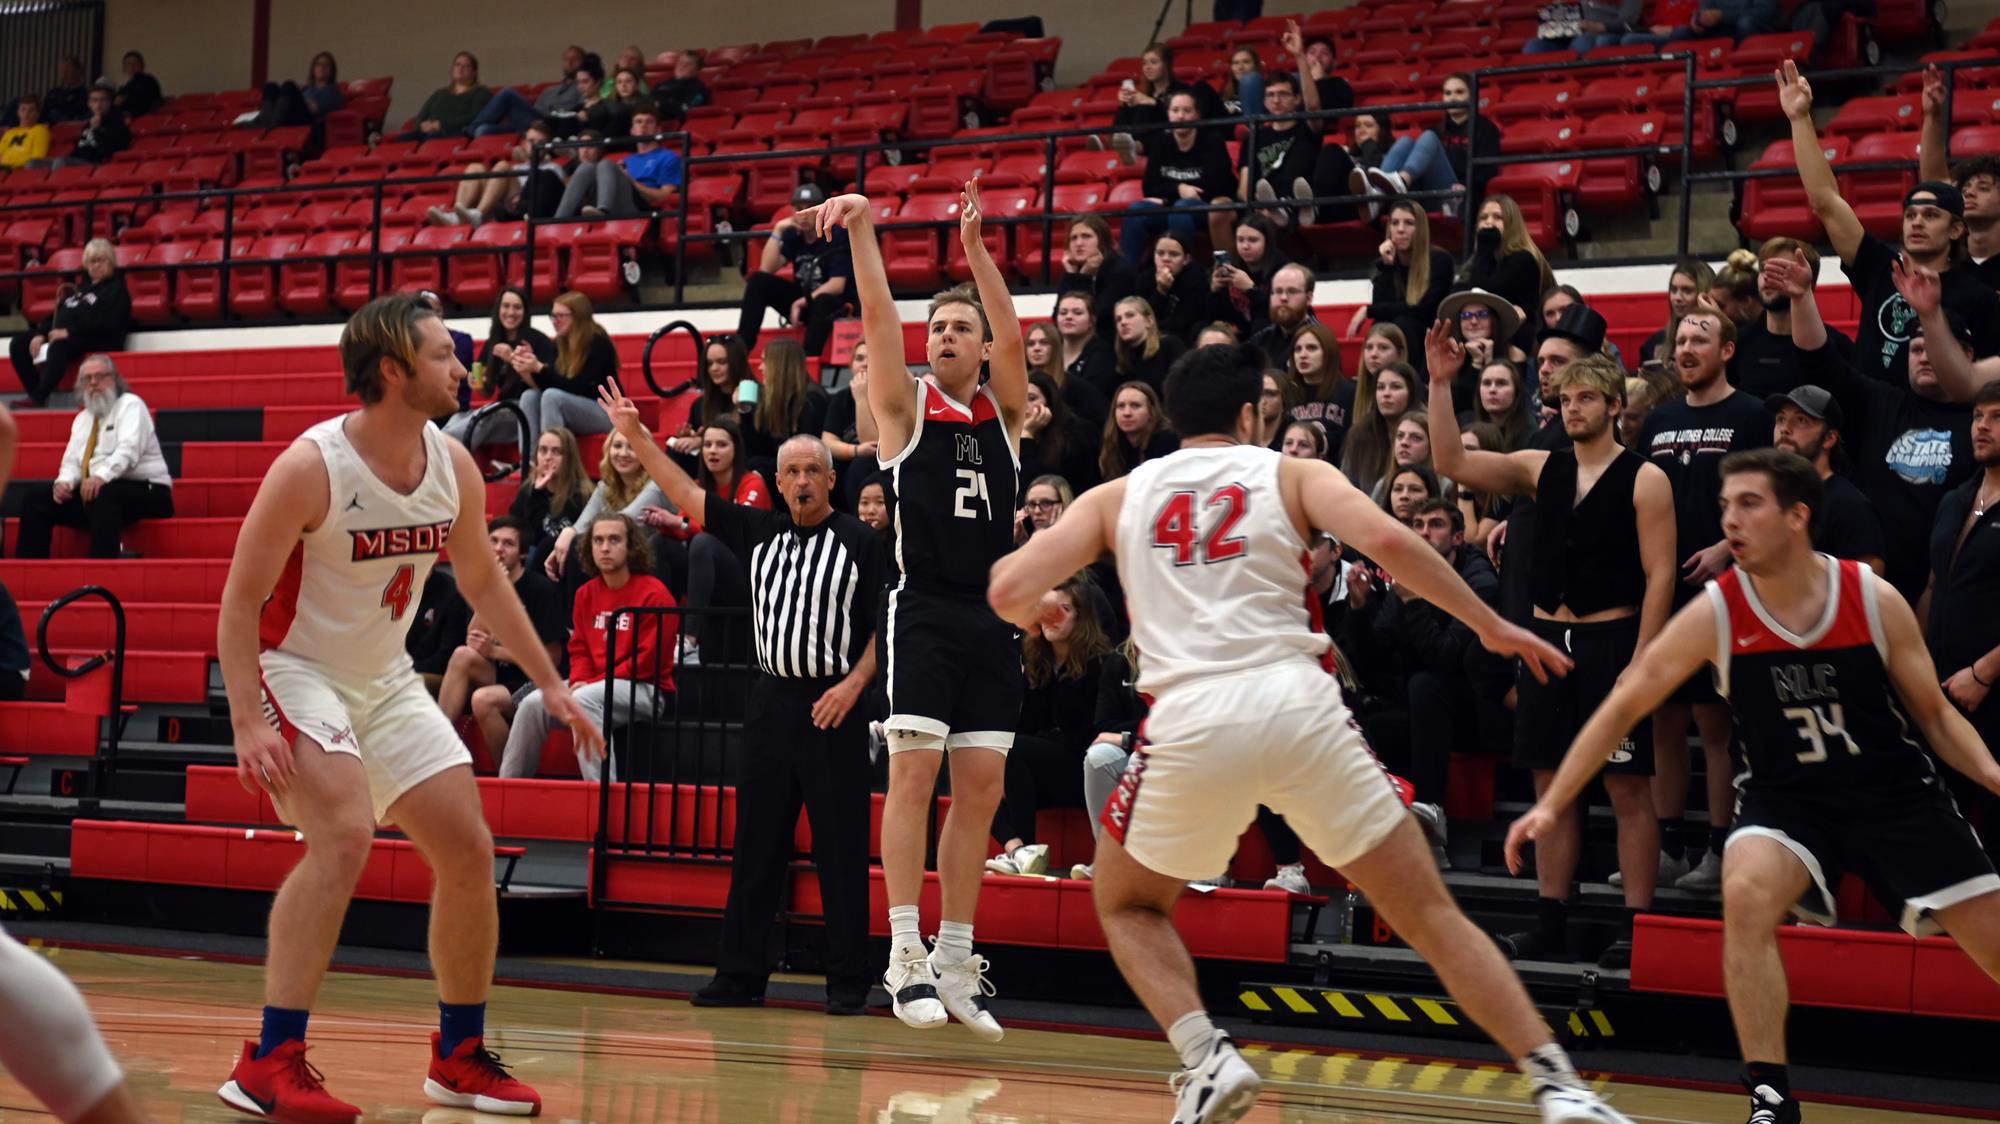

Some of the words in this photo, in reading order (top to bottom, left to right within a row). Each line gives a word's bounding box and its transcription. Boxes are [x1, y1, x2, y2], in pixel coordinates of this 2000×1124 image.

[954, 433, 983, 465] ML
[1677, 428, 1703, 443] LUTHER
[1703, 427, 1735, 442] COLLEGE
[1901, 435, 1950, 456] STATE
[1886, 447, 1953, 467] CHAMPIONS
[1150, 481, 1250, 567] 42
[352, 520, 451, 561] MSOE
[380, 564, 414, 621] 4
[1770, 664, 1839, 702] MLC
[168, 718, 180, 742] D
[1783, 703, 1862, 764] 34
[61, 771, 73, 794] C
